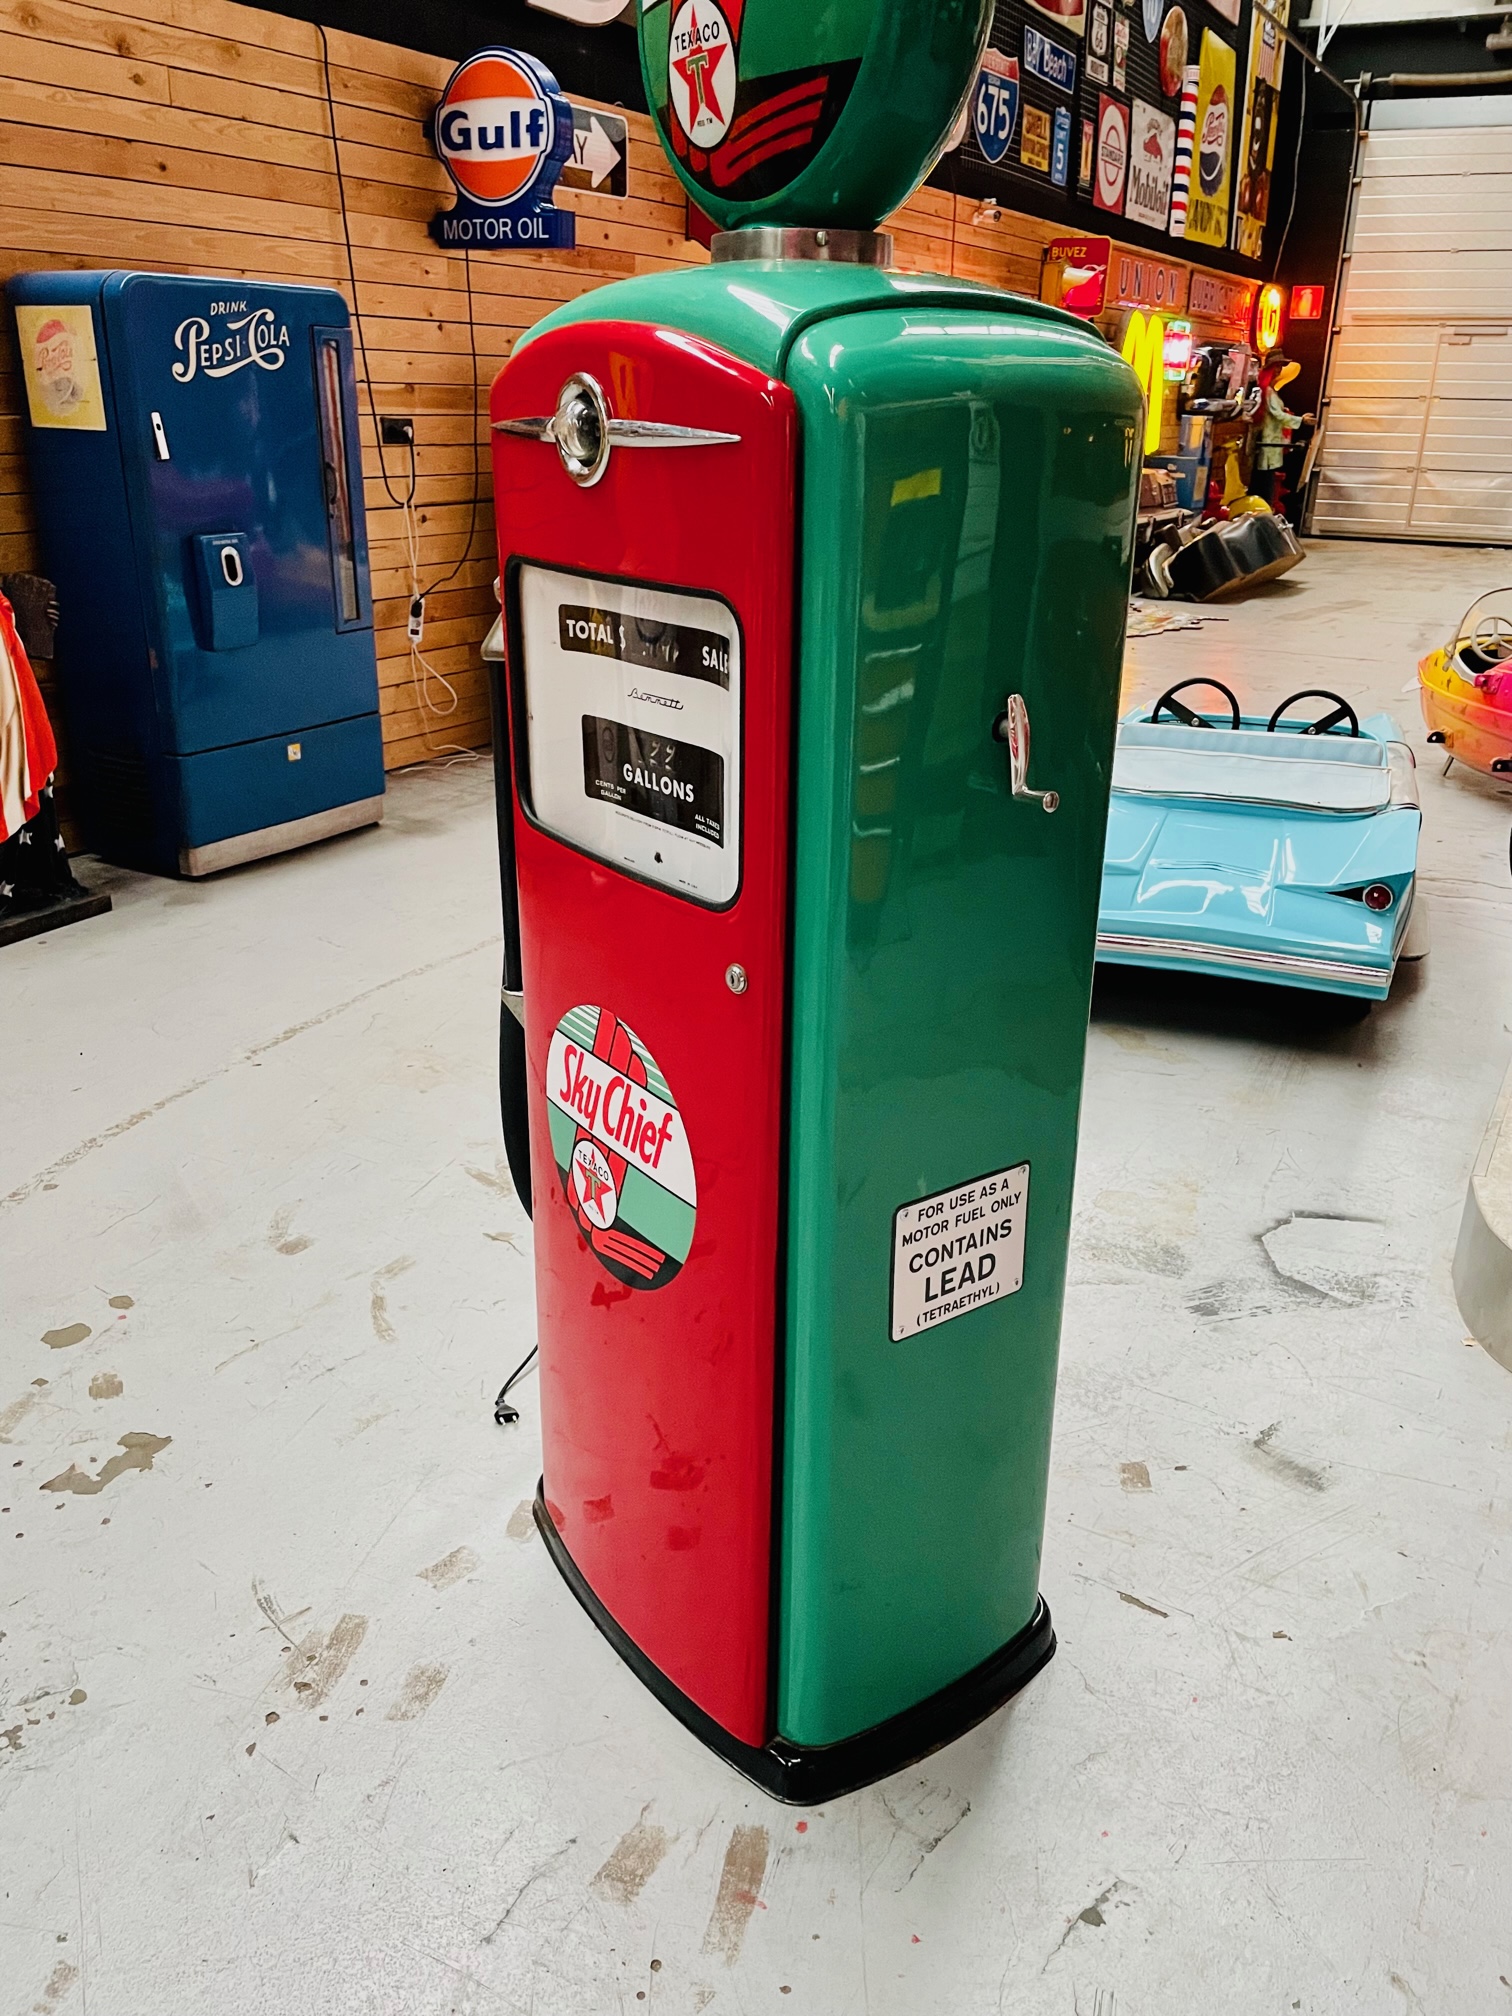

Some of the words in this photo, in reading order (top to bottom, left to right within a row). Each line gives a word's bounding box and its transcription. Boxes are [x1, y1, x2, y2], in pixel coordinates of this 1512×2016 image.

[675, 20, 720, 52] TEXACO
[1044, 43, 1067, 83] Beach
[977, 83, 1010, 140] 675
[441, 109, 545, 151] Gulf
[1056, 143, 1064, 170] 5
[1101, 145, 1124, 166] STANDARD
[444, 218, 512, 240] MOTOR
[517, 217, 549, 239] OIL
[1052, 246, 1087, 258] BUVEZ
[1119, 257, 1178, 306] UNION
[210, 300, 247, 316] DRINK
[565, 619, 614, 645] TOTAL
[702, 646, 728, 674] SALE
[628, 687, 684, 711] Bennett
[595, 779, 614, 790] CENTS
[616, 786, 627, 795] PER
[600, 789, 622, 801] GALLON
[623, 763, 694, 803] GALLONS
[694, 813, 705, 824] ALL
[706, 818, 720, 831] TAXES
[695, 823, 720, 840] INCLUDED
[559, 1044, 602, 1132] Sky
[602, 1075, 673, 1170] Chief
[578, 1149, 609, 1181] TEXACO
[918, 1202, 944, 1222] FOR
[950, 1190, 976, 1210] USE
[979, 1182, 997, 1200] AS
[1001, 1178, 1009, 1192] A
[902, 1220, 949, 1247] MOTOR
[955, 1206, 986, 1228] FUEL
[991, 1191, 1022, 1213] ONLY
[909, 1219, 1012, 1274] CONTAINS
[925, 1253, 996, 1303] LEAD
[916, 1282, 1000, 1327] (TETRAETHYL)
